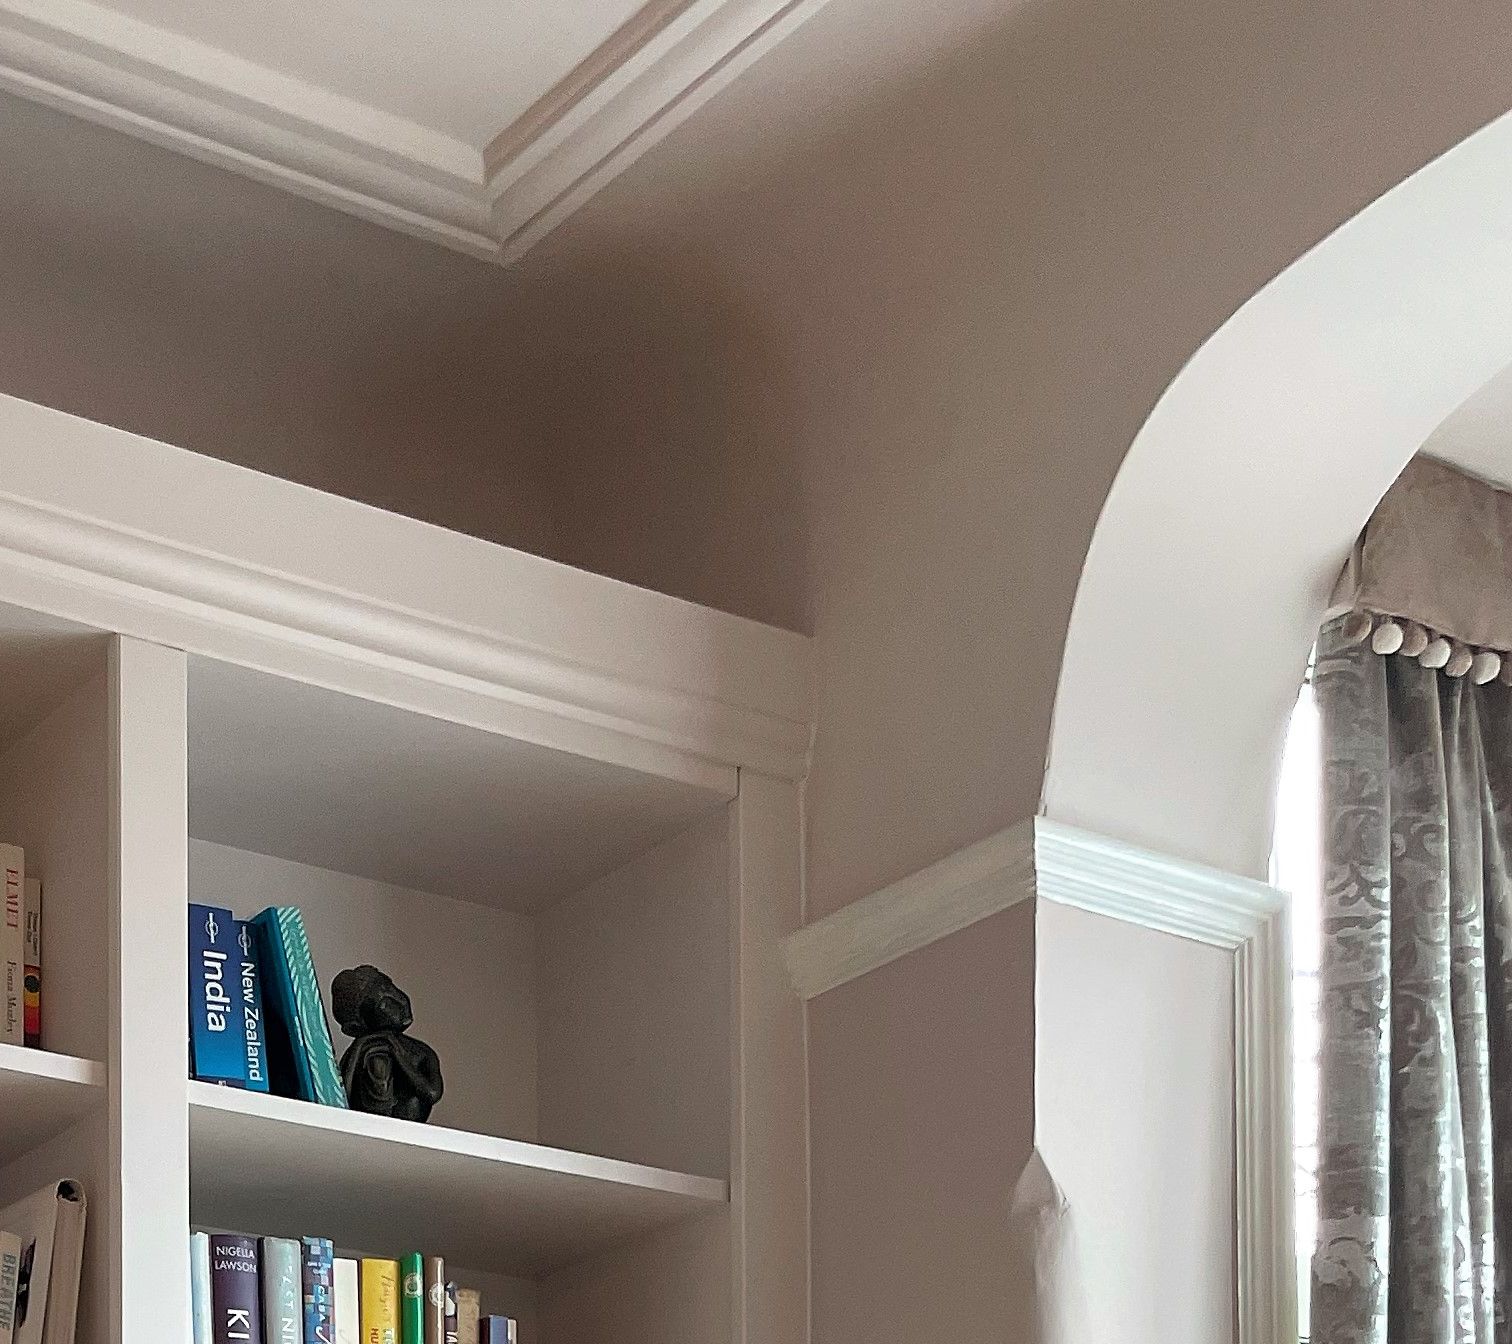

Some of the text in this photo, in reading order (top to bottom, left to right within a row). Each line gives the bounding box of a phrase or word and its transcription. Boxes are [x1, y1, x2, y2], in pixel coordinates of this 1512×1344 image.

[6, 868, 18, 930] ELMET
[202, 950, 232, 1034] India
[239, 962, 264, 1082] New Zealand
[214, 1261, 257, 1272] LAWSON
[216, 1246, 255, 1259] NIGELLA
[317, 1285, 326, 1323] CASA
